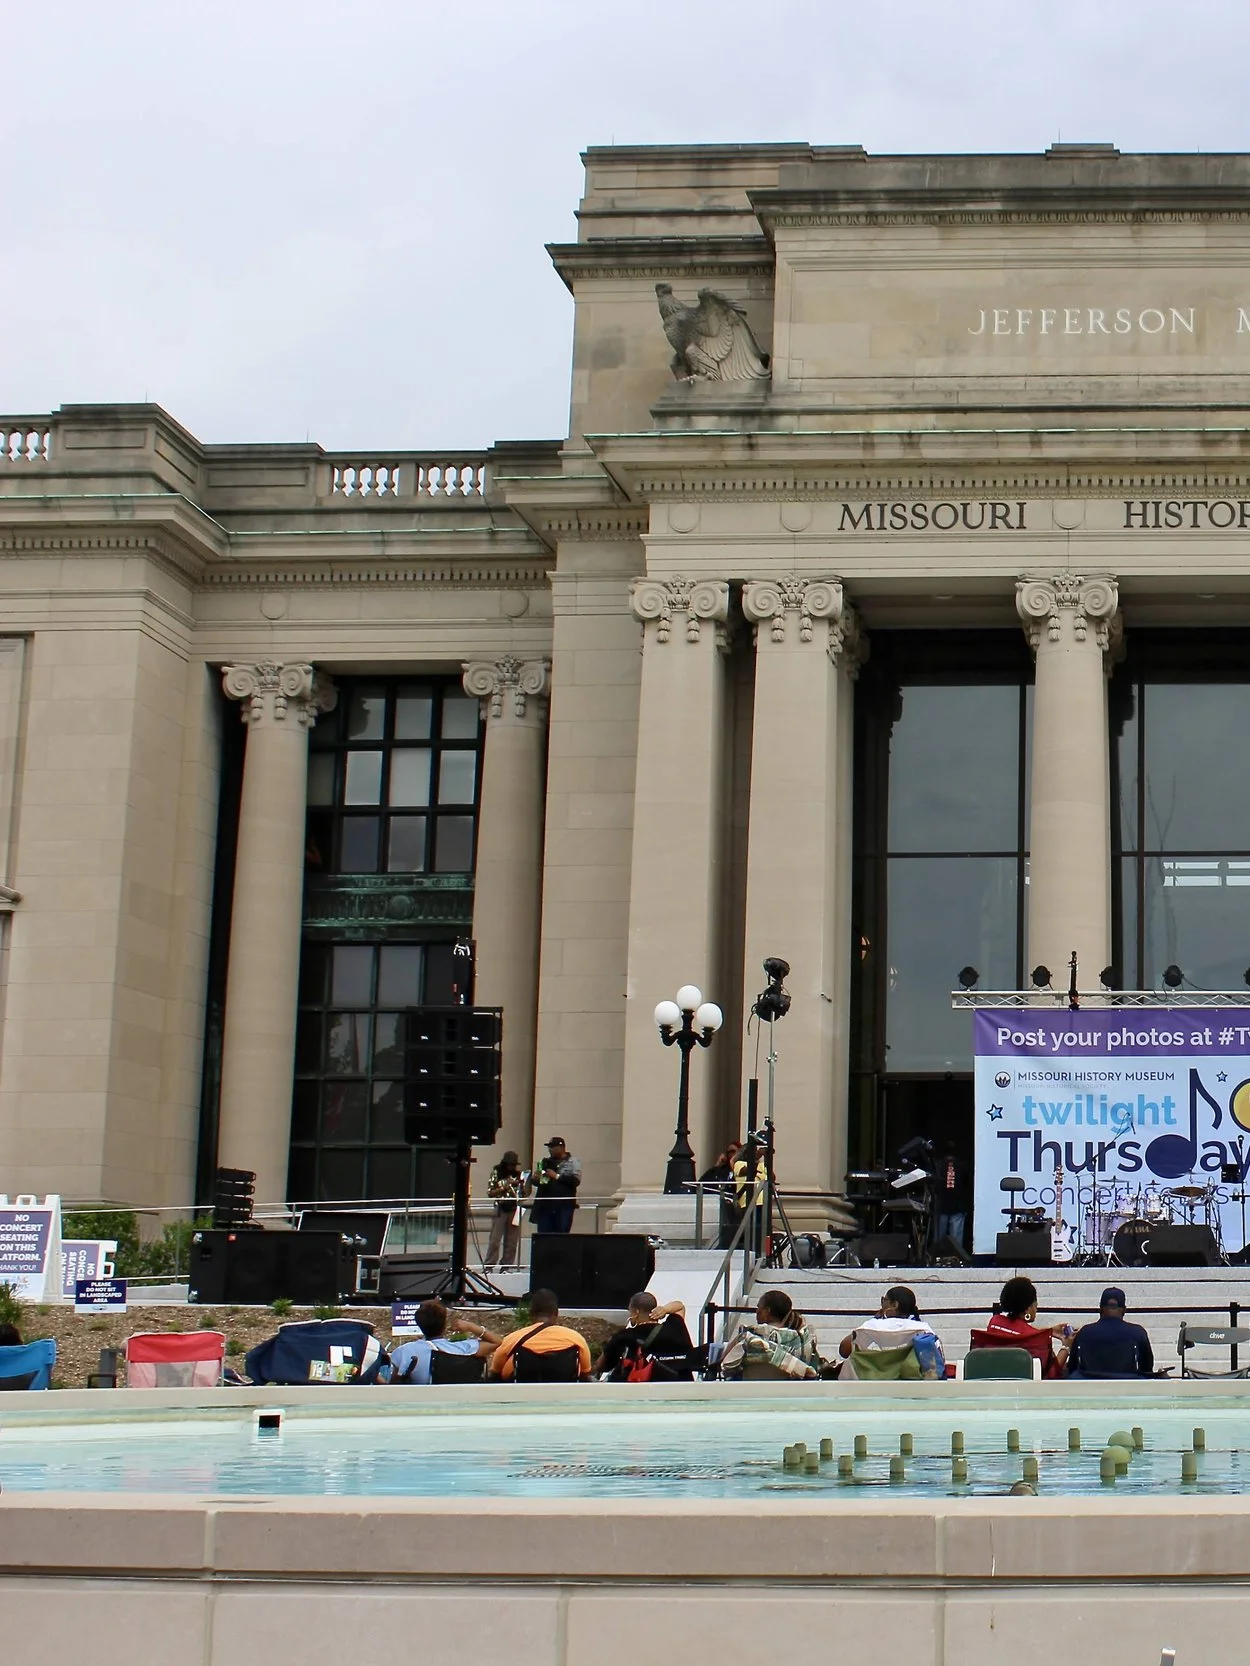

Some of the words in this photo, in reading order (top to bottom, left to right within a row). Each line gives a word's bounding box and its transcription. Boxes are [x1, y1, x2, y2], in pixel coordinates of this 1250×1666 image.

[968, 307, 1195, 335] JEFFERSON
[837, 502, 1028, 531] MISSOURI
[997, 1027, 1046, 1046] Post
[1051, 1031, 1102, 1051] your
[1107, 1027, 1185, 1051] photos
[1190, 1027, 1213, 1046] at
[1018, 1071, 1072, 1081] MISSOURI
[1075, 1071, 1122, 1081] HISTORY
[1125, 1071, 1175, 1081] MUSEUM
[1022, 1094, 1177, 1133] twilight
[66, 1252, 77, 1286] SEATING
[87, 1263, 95, 1276] NO
